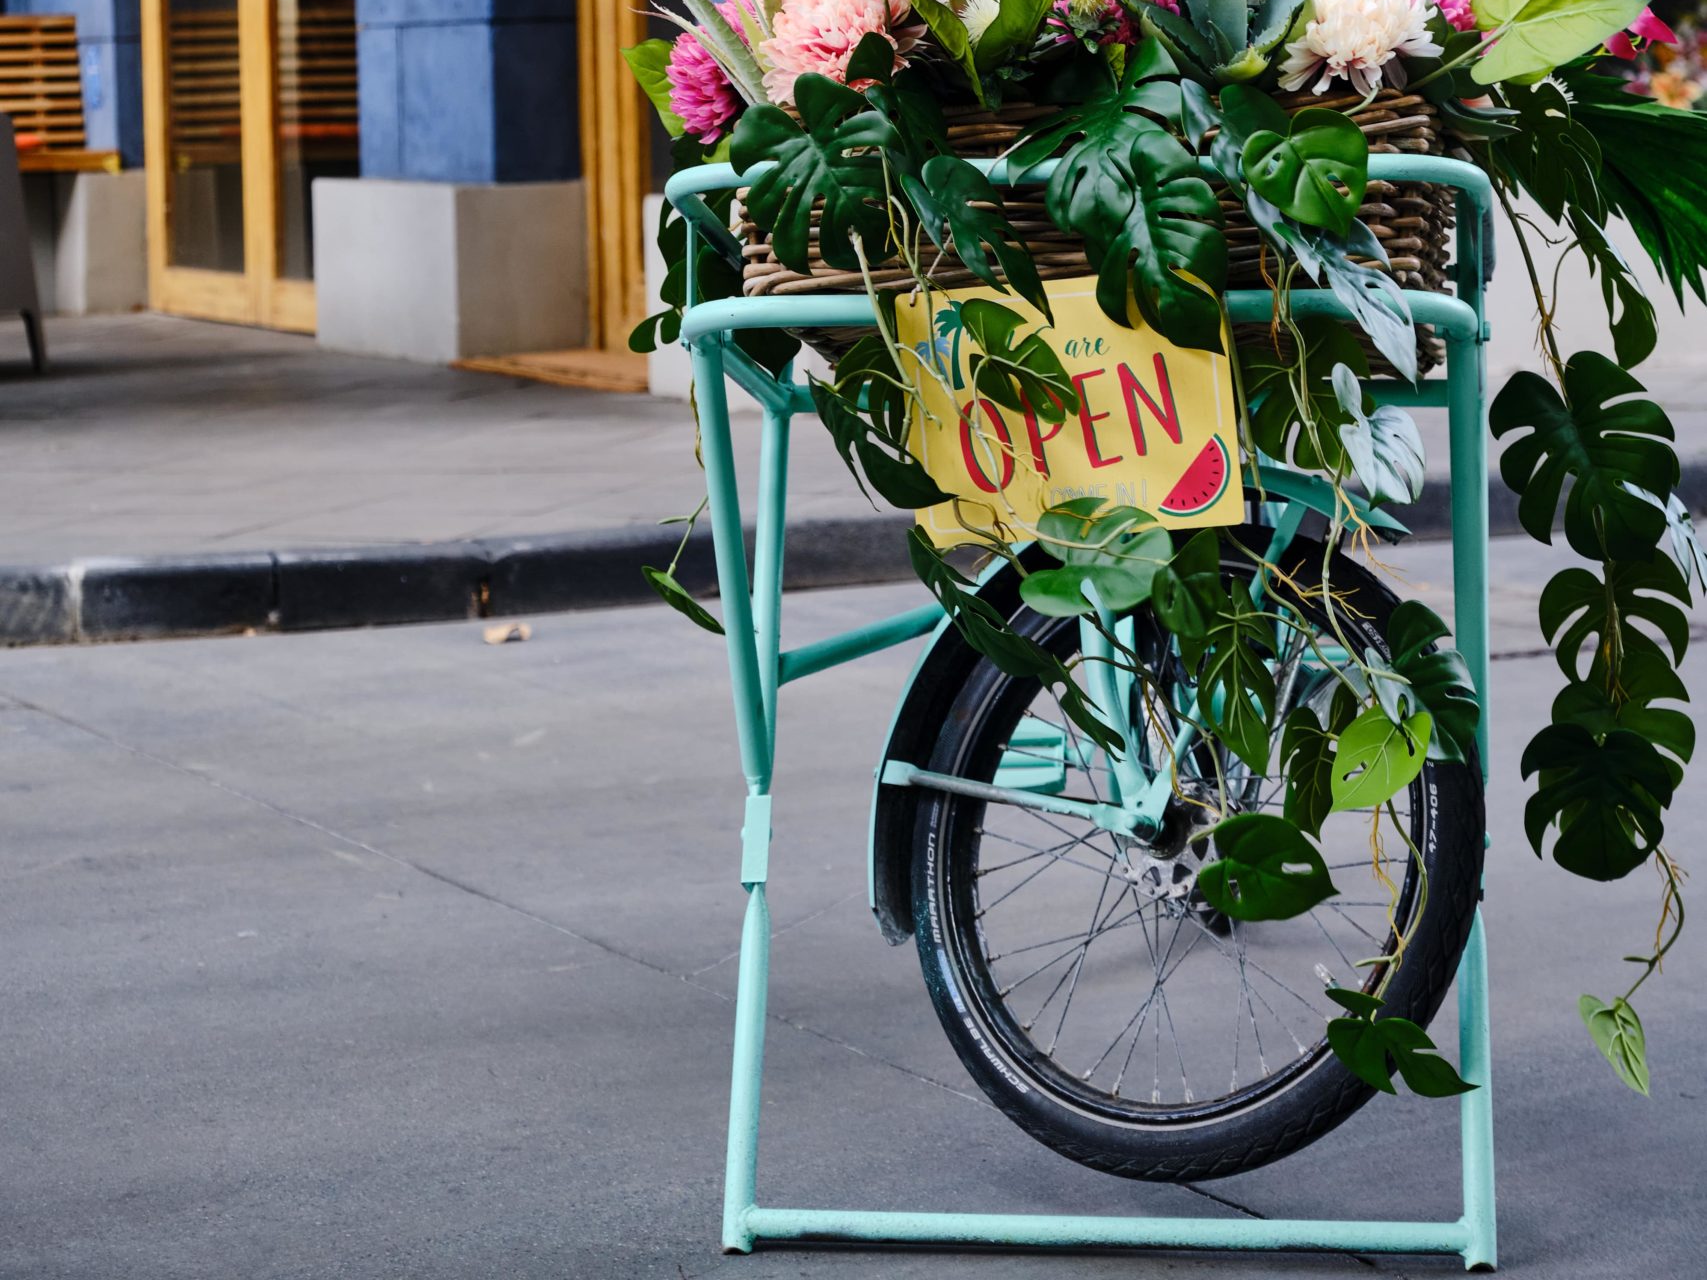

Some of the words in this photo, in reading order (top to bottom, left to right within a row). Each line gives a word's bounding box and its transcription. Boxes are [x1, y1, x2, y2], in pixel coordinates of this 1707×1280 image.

[1065, 335, 1111, 359] are
[959, 351, 1183, 494] OPEN
[926, 831, 942, 944] MARATHON
[962, 1016, 1031, 1095] SCHWALBE
